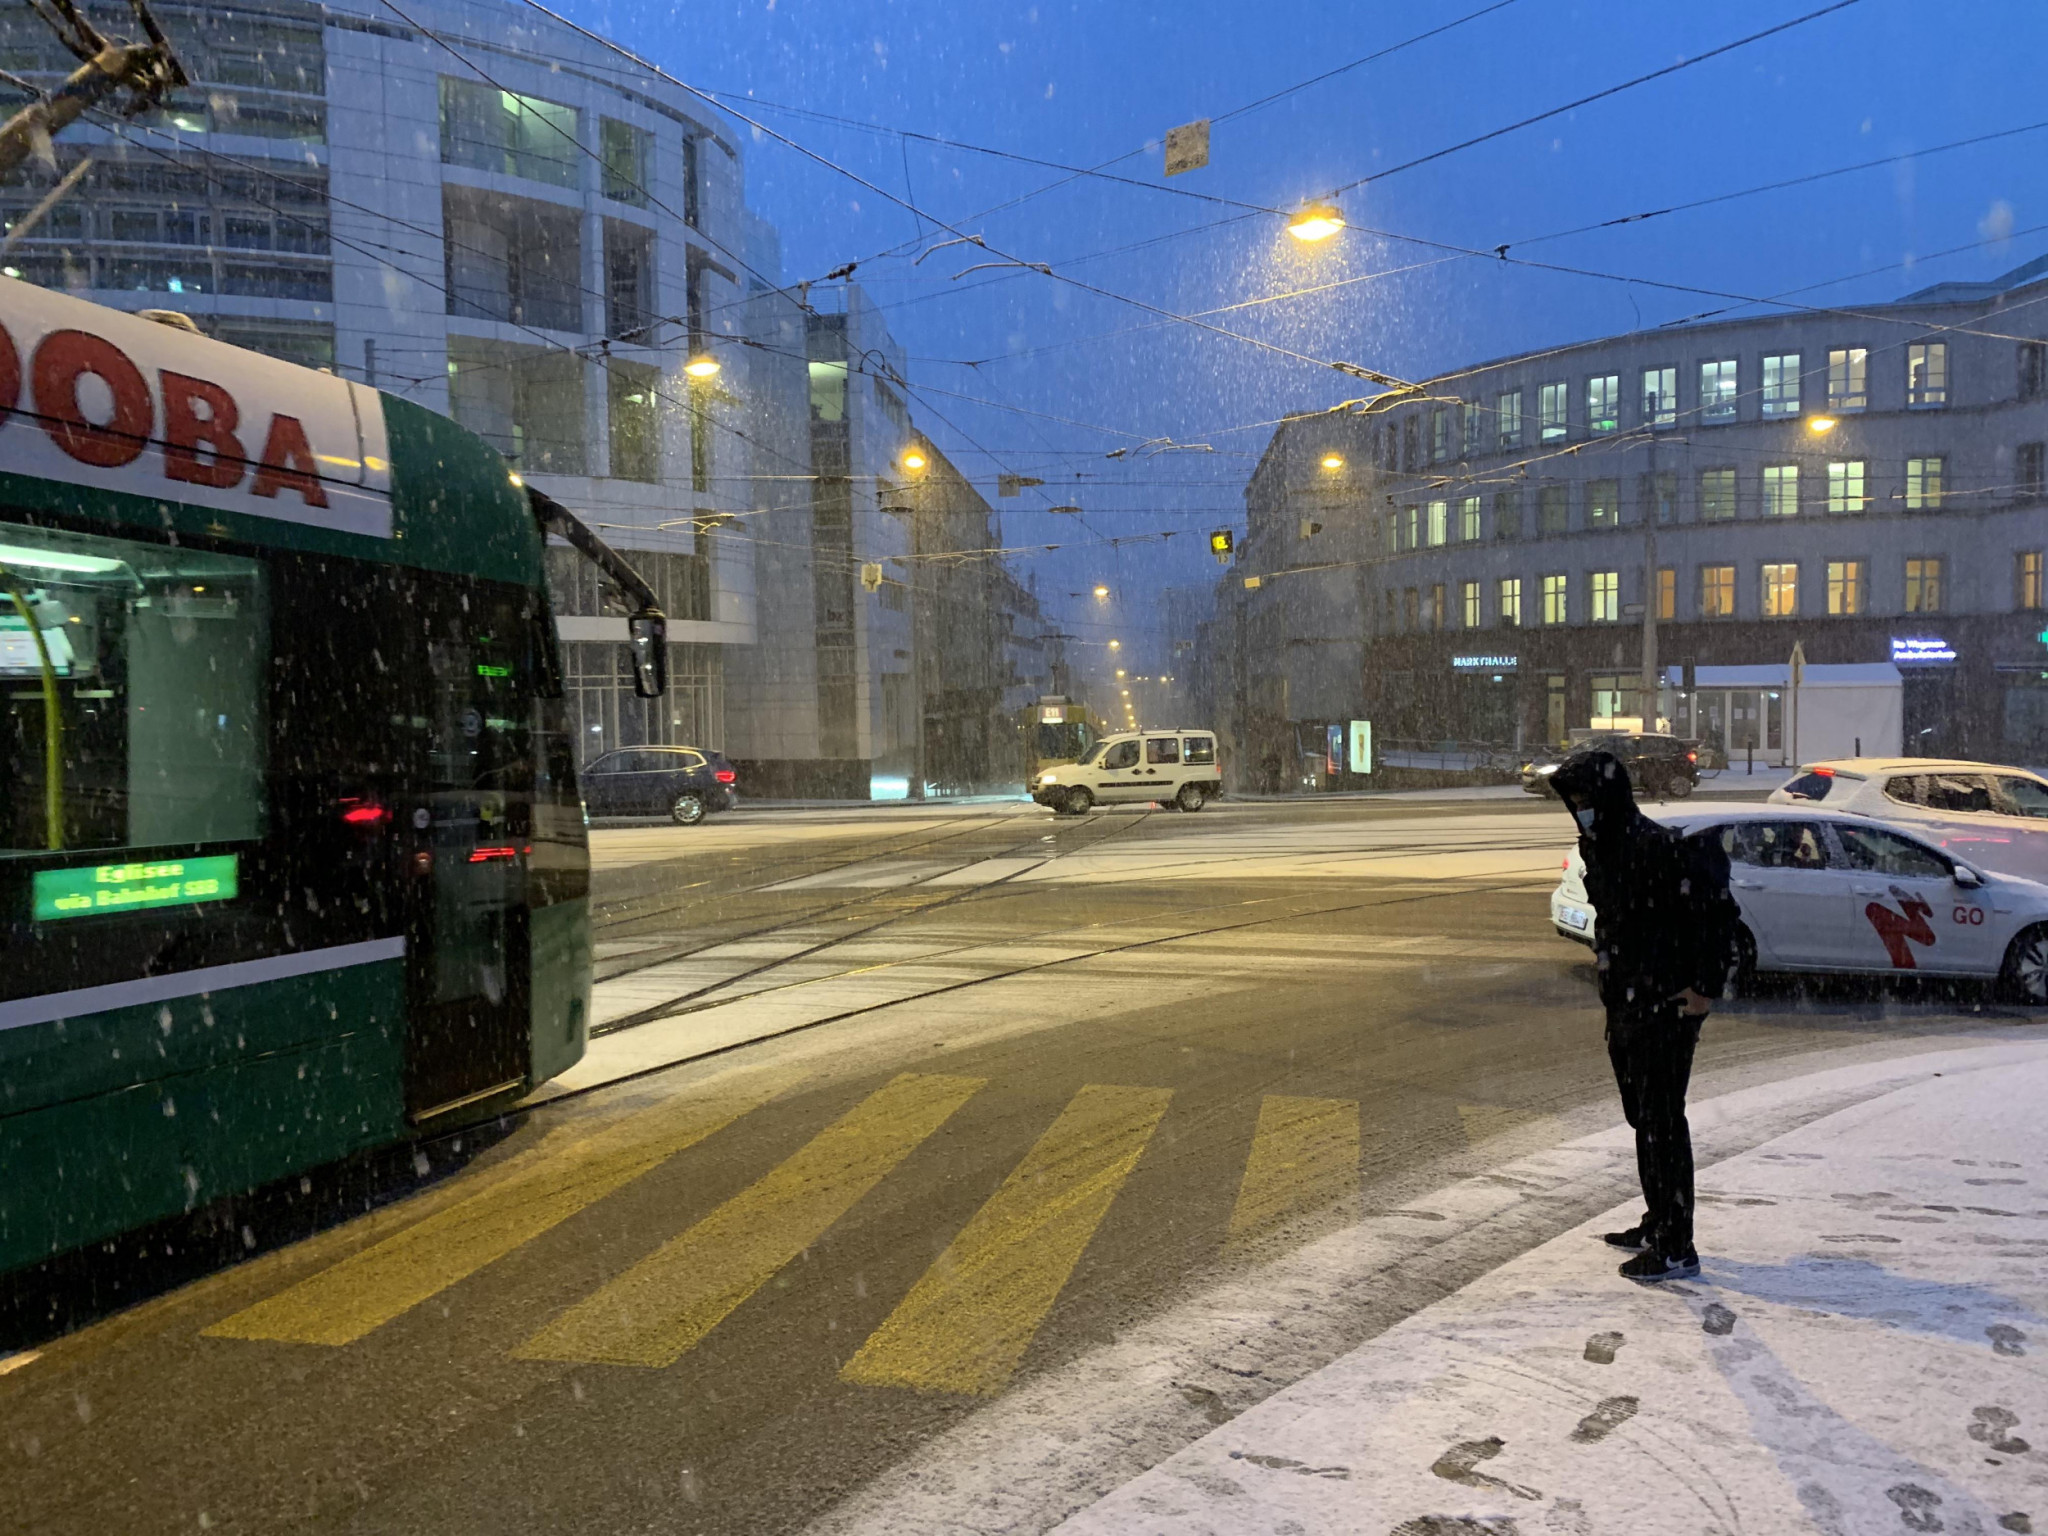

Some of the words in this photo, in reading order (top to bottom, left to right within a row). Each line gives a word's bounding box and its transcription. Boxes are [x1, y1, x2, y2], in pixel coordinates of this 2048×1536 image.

[0, 319, 330, 509] OBA
[1453, 656, 1518, 667] MARKTHALLE
[96, 864, 184, 883] Eglisee
[96, 883, 180, 906] Bahnhof
[1952, 906, 1985, 926] GO
